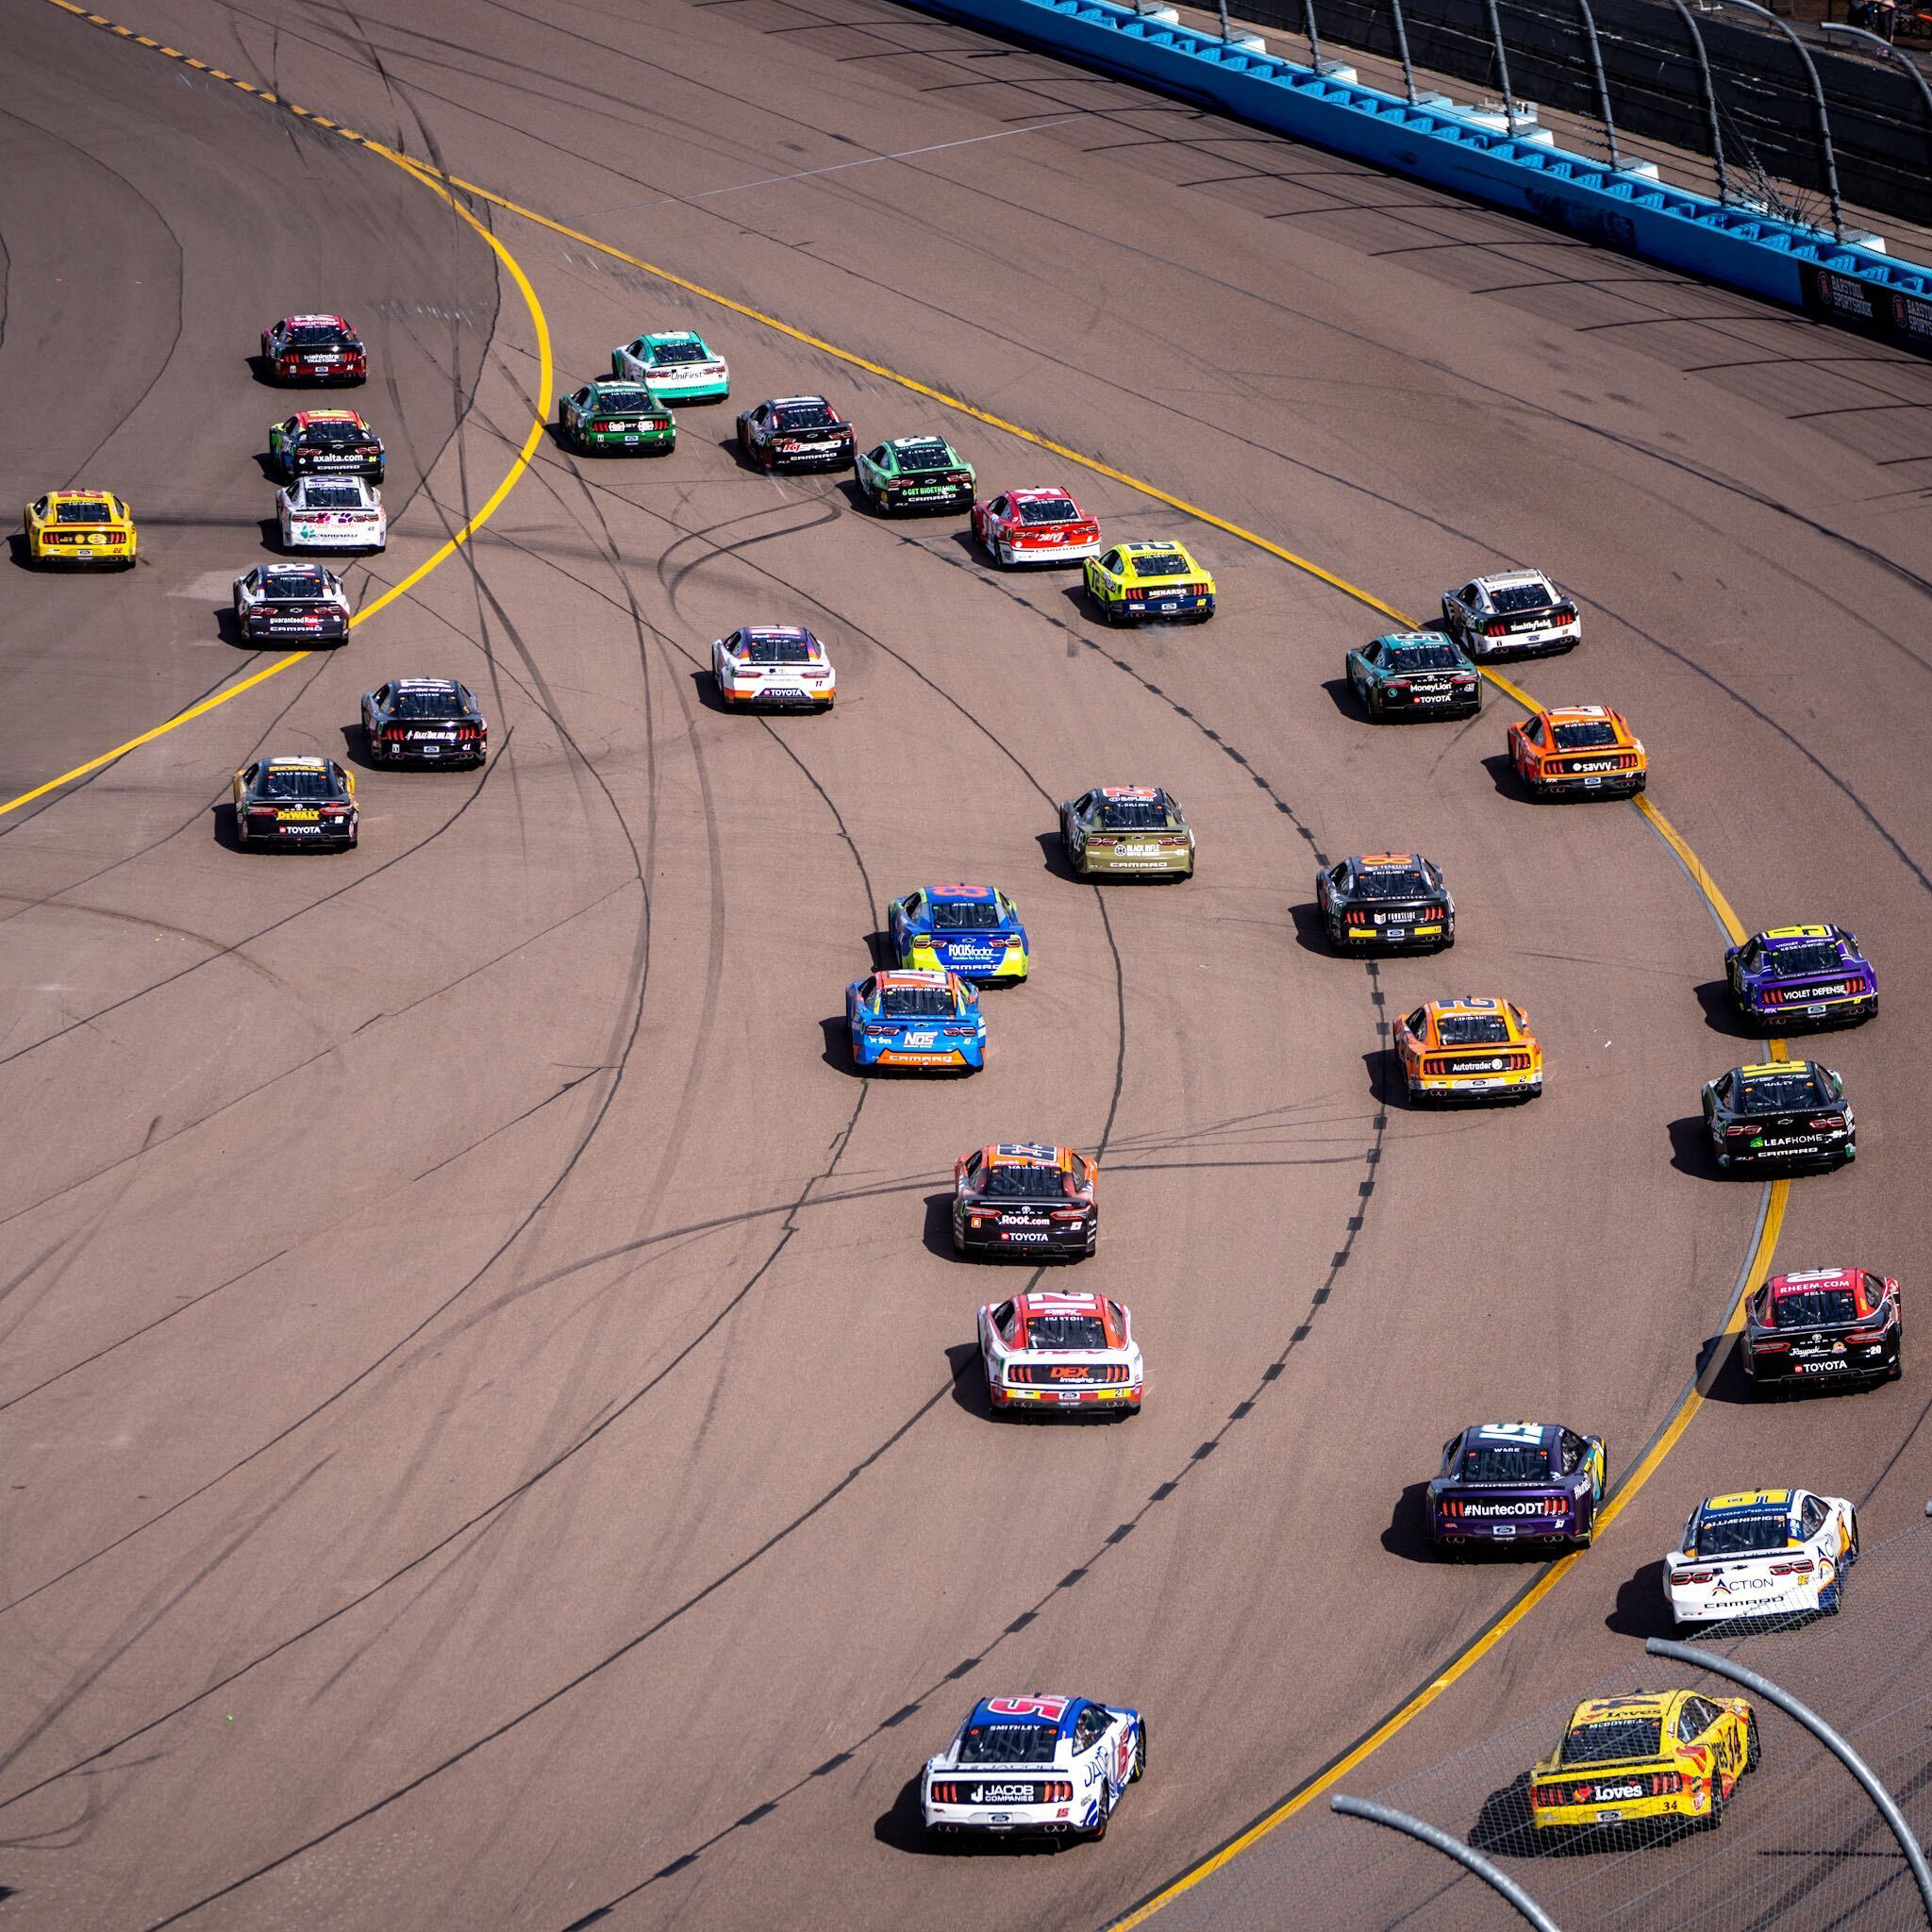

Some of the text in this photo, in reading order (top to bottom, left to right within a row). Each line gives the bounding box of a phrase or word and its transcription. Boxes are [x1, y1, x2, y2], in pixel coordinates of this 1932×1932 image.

[1831, 275, 1864, 299] BARSTOOL
[1833, 291, 1873, 317] SPORTSBOOK
[313, 454, 363, 462] axalta.com
[920, 485, 958, 494] BIOETHANOL
[1510, 619, 1552, 632] Smithfield
[1410, 682, 1452, 692] MoneyLion
[1420, 694, 1451, 704] TOYOTA
[1583, 761, 1612, 772] savvy
[277, 811, 320, 820] DEWALT
[1784, 985, 1846, 1000] VIOLET DEFENSE
[904, 1031, 939, 1045] NOS
[1453, 1062, 1491, 1072] Autotrader
[1764, 1134, 1824, 1147] LEAFHOME
[1002, 1215, 1050, 1225] Root.com
[1009, 1233, 1048, 1241] TOYOTA
[1780, 1281, 1850, 1293] RHEEM.COM
[1790, 1346, 1821, 1357] Raypak
[1050, 1366, 1091, 1377] DEX
[1803, 1360, 1847, 1373] TOYOTA
[1115, 1389, 1124, 1397] 21
[1464, 1502, 1544, 1516] #NurtecODT
[1712, 1578, 1774, 1596] ACTION
[1704, 1596, 1784, 1608] CAMARO
[985, 1785, 1034, 1795] JACOB
[1662, 1801, 1678, 1811] 34
[1057, 1808, 1069, 1818] 15
